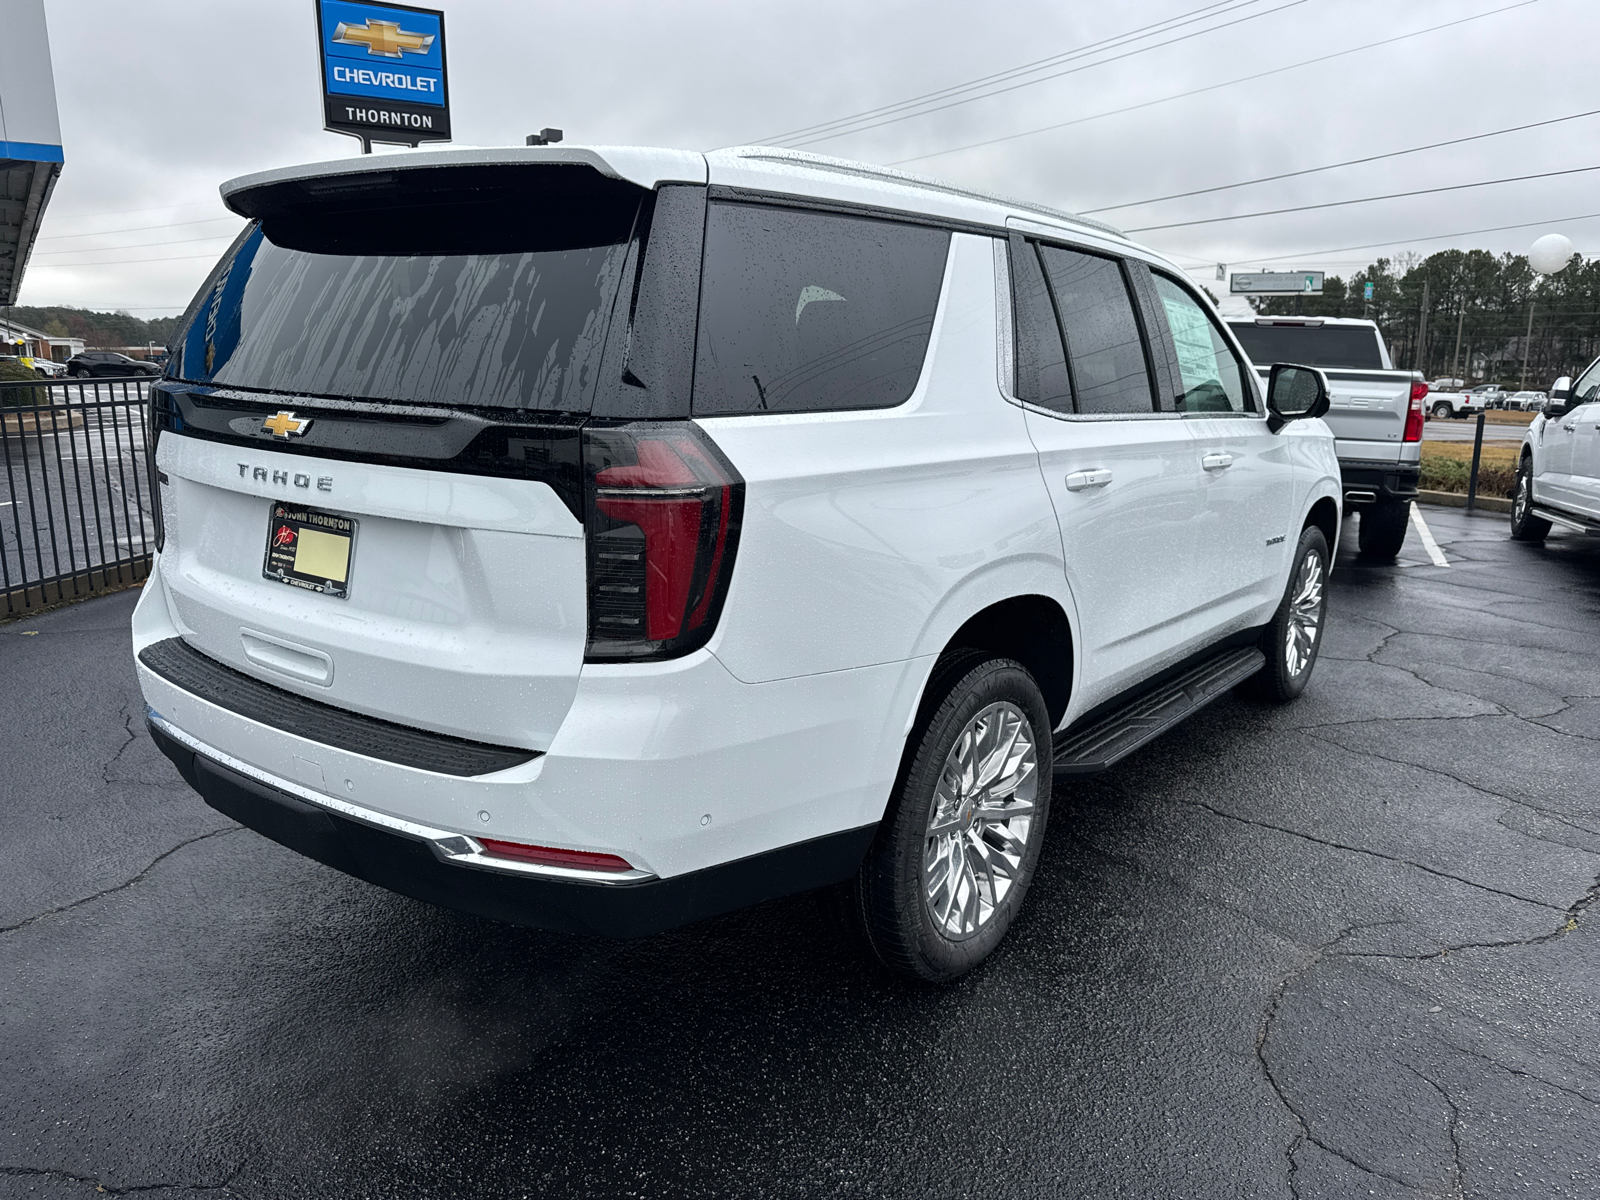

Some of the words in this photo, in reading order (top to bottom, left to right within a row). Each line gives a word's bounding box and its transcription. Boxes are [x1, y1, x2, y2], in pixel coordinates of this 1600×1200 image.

[333, 66, 438, 92] CHEVROLET
[345, 107, 433, 128] THORNTON
[237, 462, 334, 493] TAHOE
[308, 513, 351, 531] THORNTON
